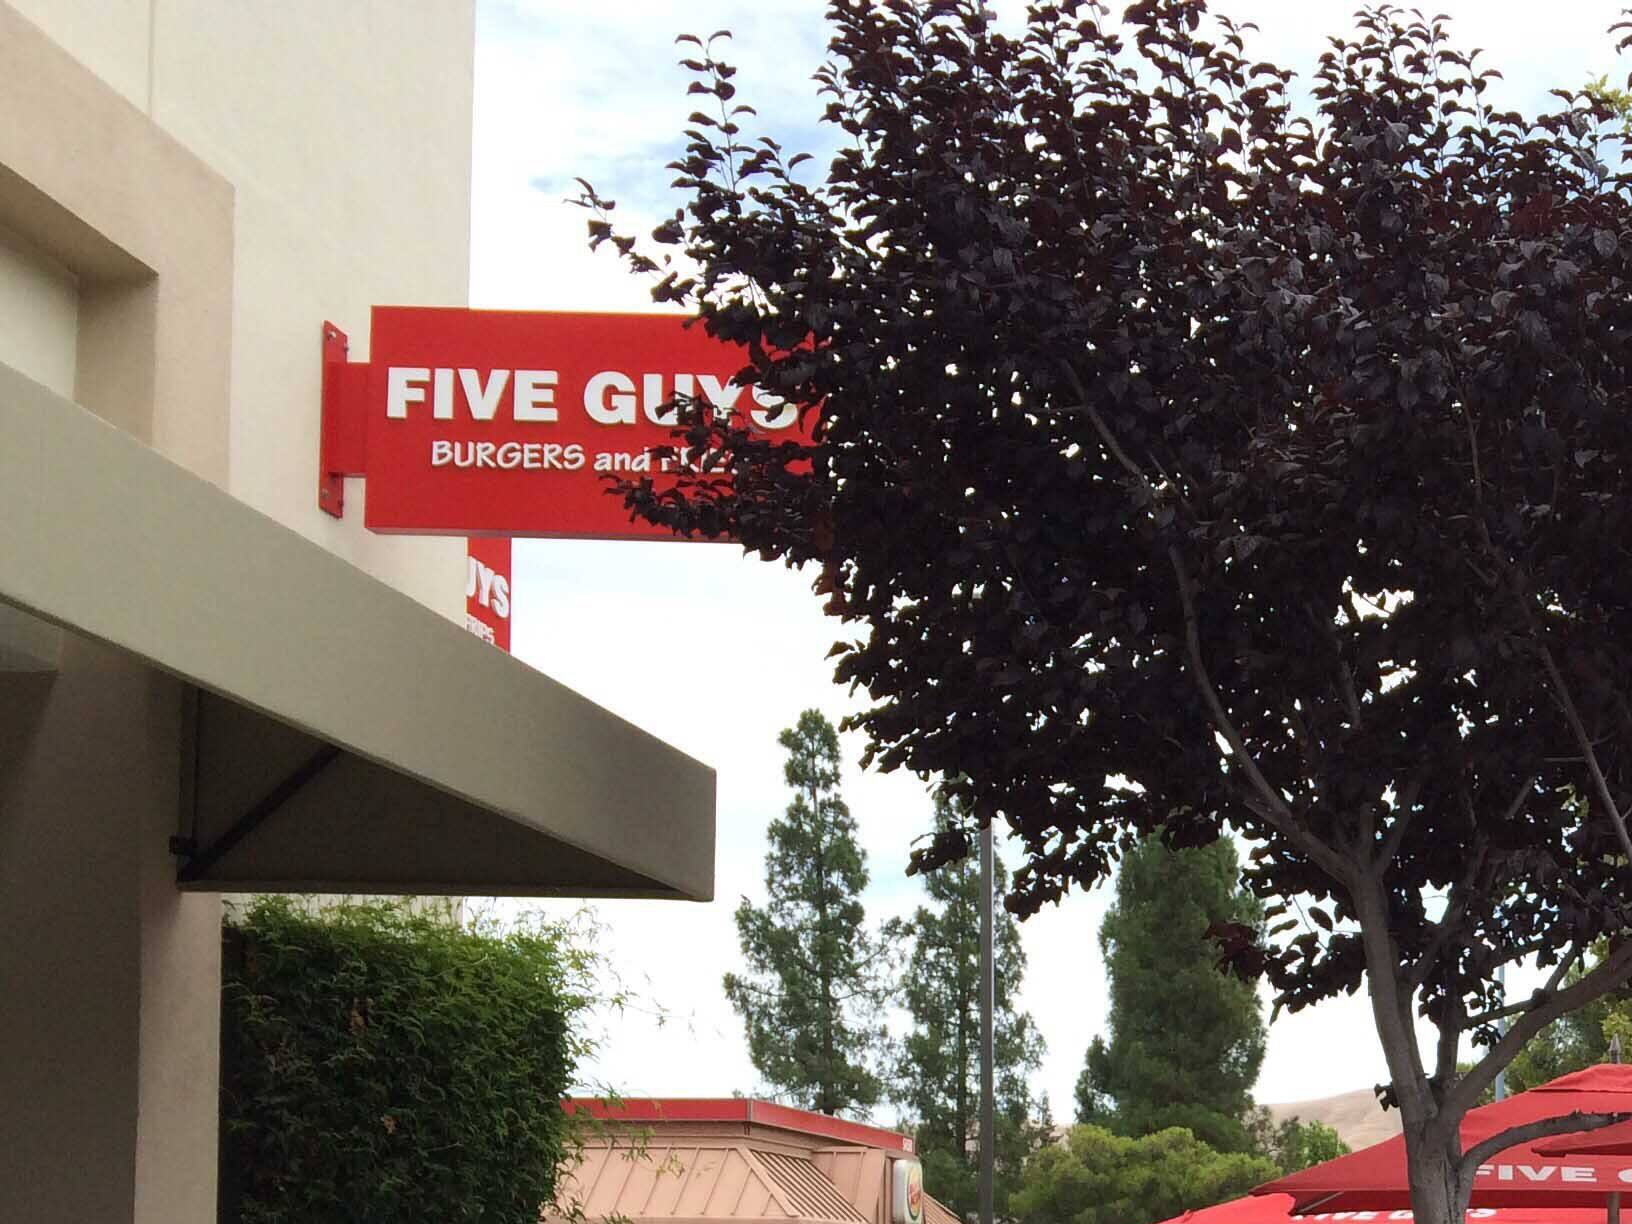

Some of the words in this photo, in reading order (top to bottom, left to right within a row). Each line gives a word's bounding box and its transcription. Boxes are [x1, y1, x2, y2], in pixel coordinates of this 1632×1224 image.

[386, 366, 559, 423] FIVE
[583, 370, 799, 430] GUYS
[431, 440, 586, 471] BURGERS
[593, 447, 651, 473] and
[1475, 1164, 1597, 1183] FIVE
